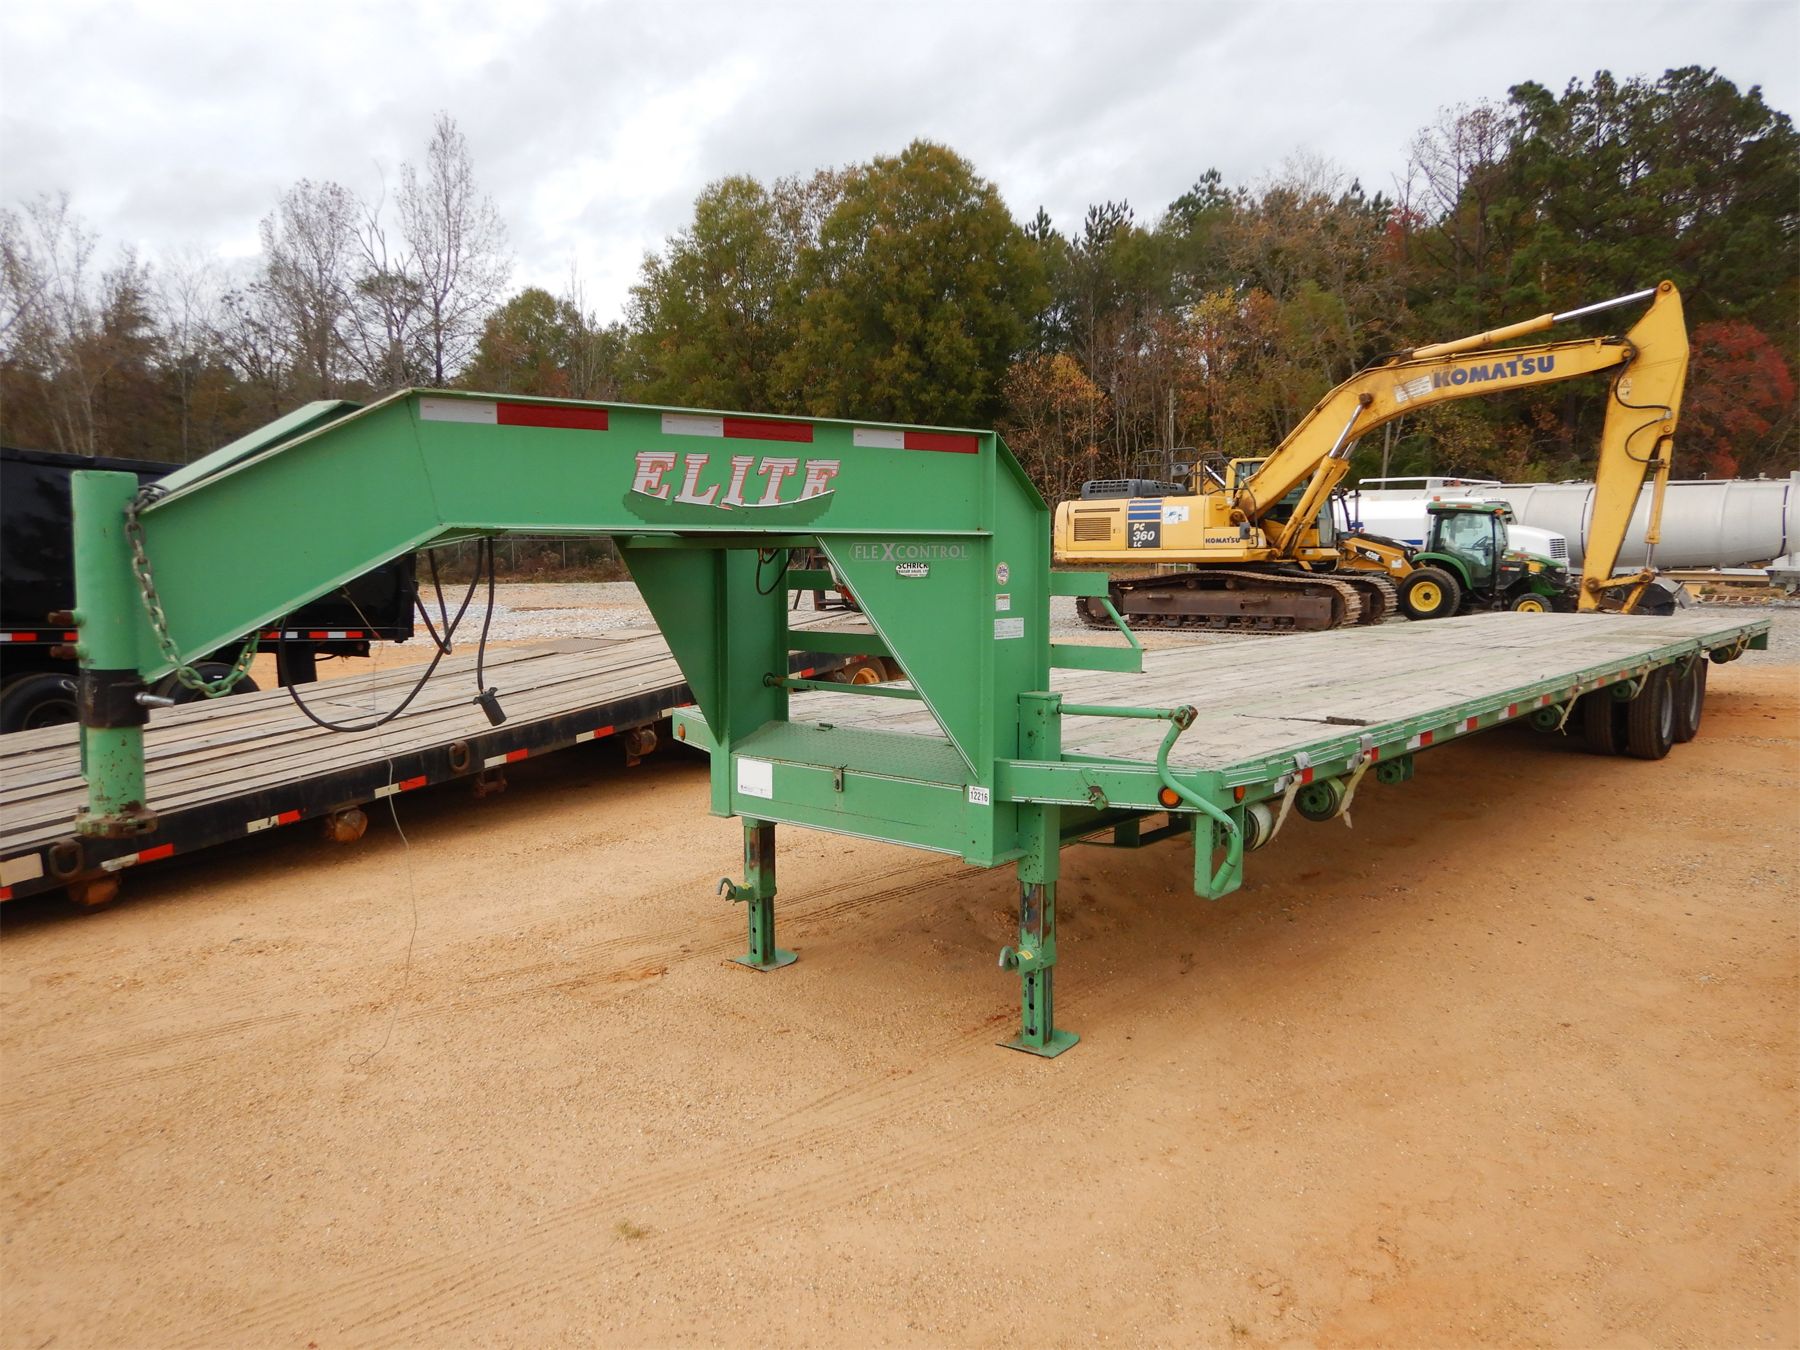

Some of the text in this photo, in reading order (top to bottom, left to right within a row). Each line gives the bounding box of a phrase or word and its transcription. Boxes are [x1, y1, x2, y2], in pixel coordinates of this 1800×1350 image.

[1433, 354, 1554, 388] KOMATSU
[632, 452, 840, 509] ELITE
[1133, 523, 1145, 531] PC
[1133, 531, 1155, 540] 360
[970, 791, 988, 802] 12216
